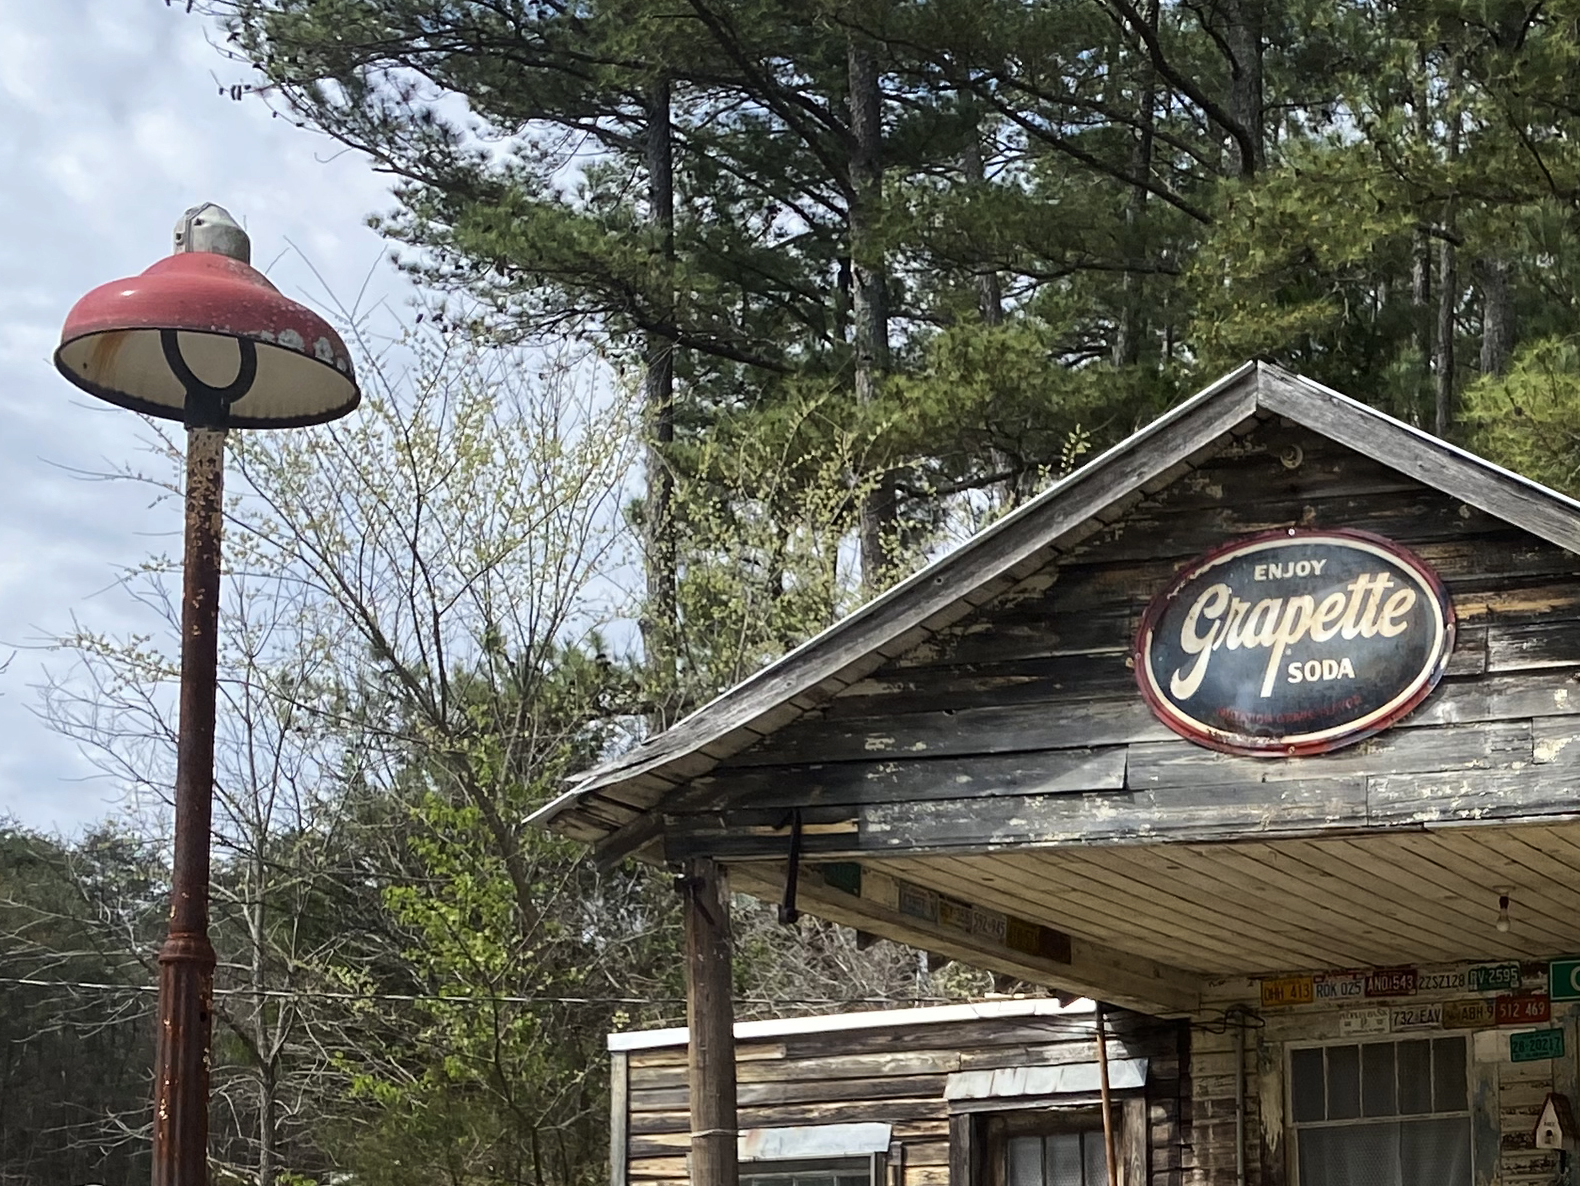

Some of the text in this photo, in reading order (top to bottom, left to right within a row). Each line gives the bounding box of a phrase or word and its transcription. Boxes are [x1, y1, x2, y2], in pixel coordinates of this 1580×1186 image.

[1253, 559, 1328, 581] ENJOY
[1169, 572, 1417, 700] Grapette
[1287, 658, 1355, 683] SODA
[1500, 1001, 1546, 1018] 512 469
